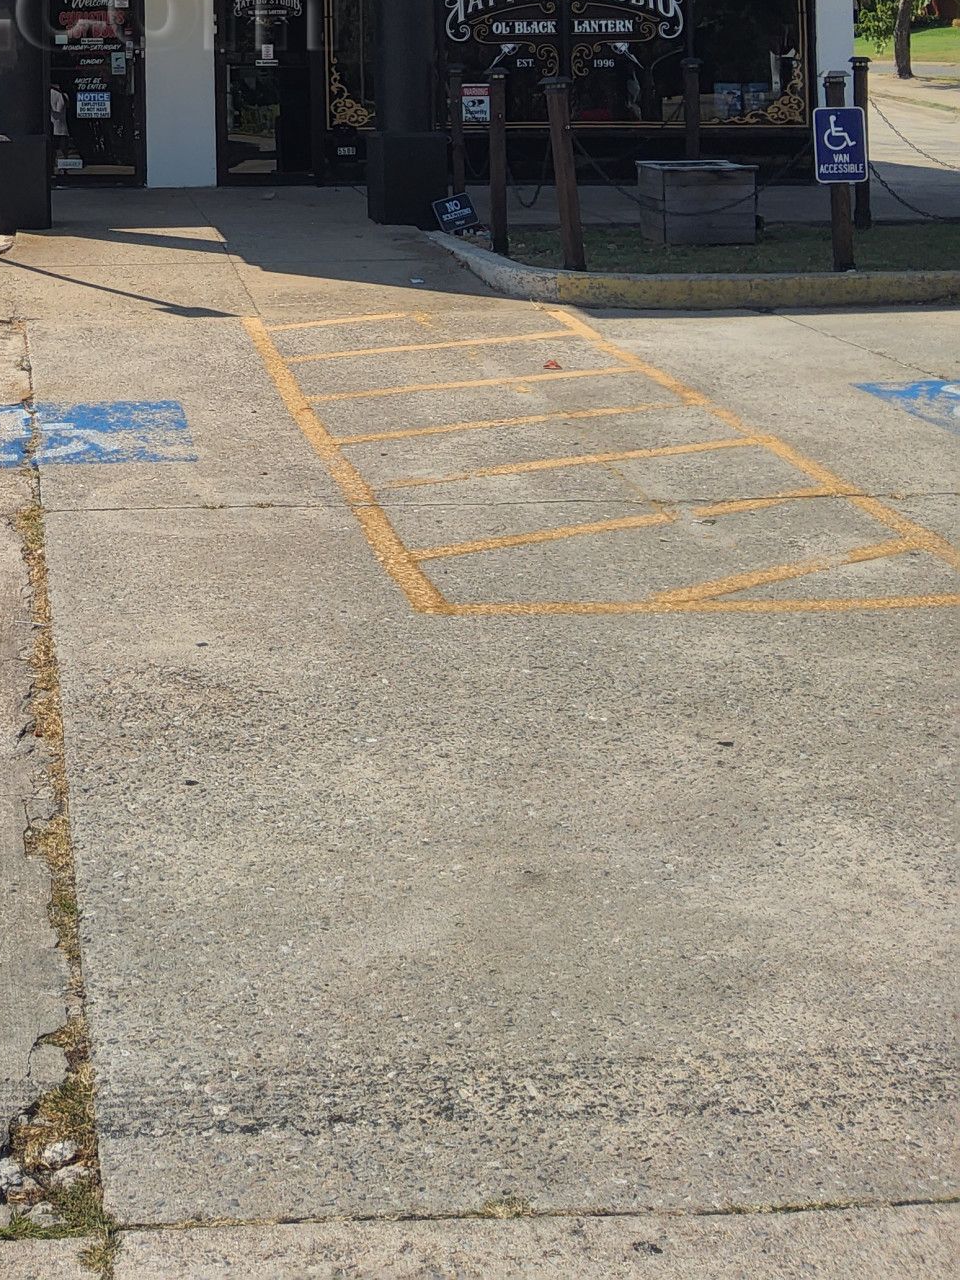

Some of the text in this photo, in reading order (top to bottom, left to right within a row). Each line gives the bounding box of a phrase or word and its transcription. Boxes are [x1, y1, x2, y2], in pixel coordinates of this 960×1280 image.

[515, 21, 557, 34] BLACK
[574, 20, 634, 33] LANTERN
[516, 59, 615, 68] EST. 1996
[77, 93, 110, 101] NOTICE
[833, 153, 849, 162] VAN
[820, 163, 864, 174] ACCESSIBLE
[445, 200, 461, 212] NO
